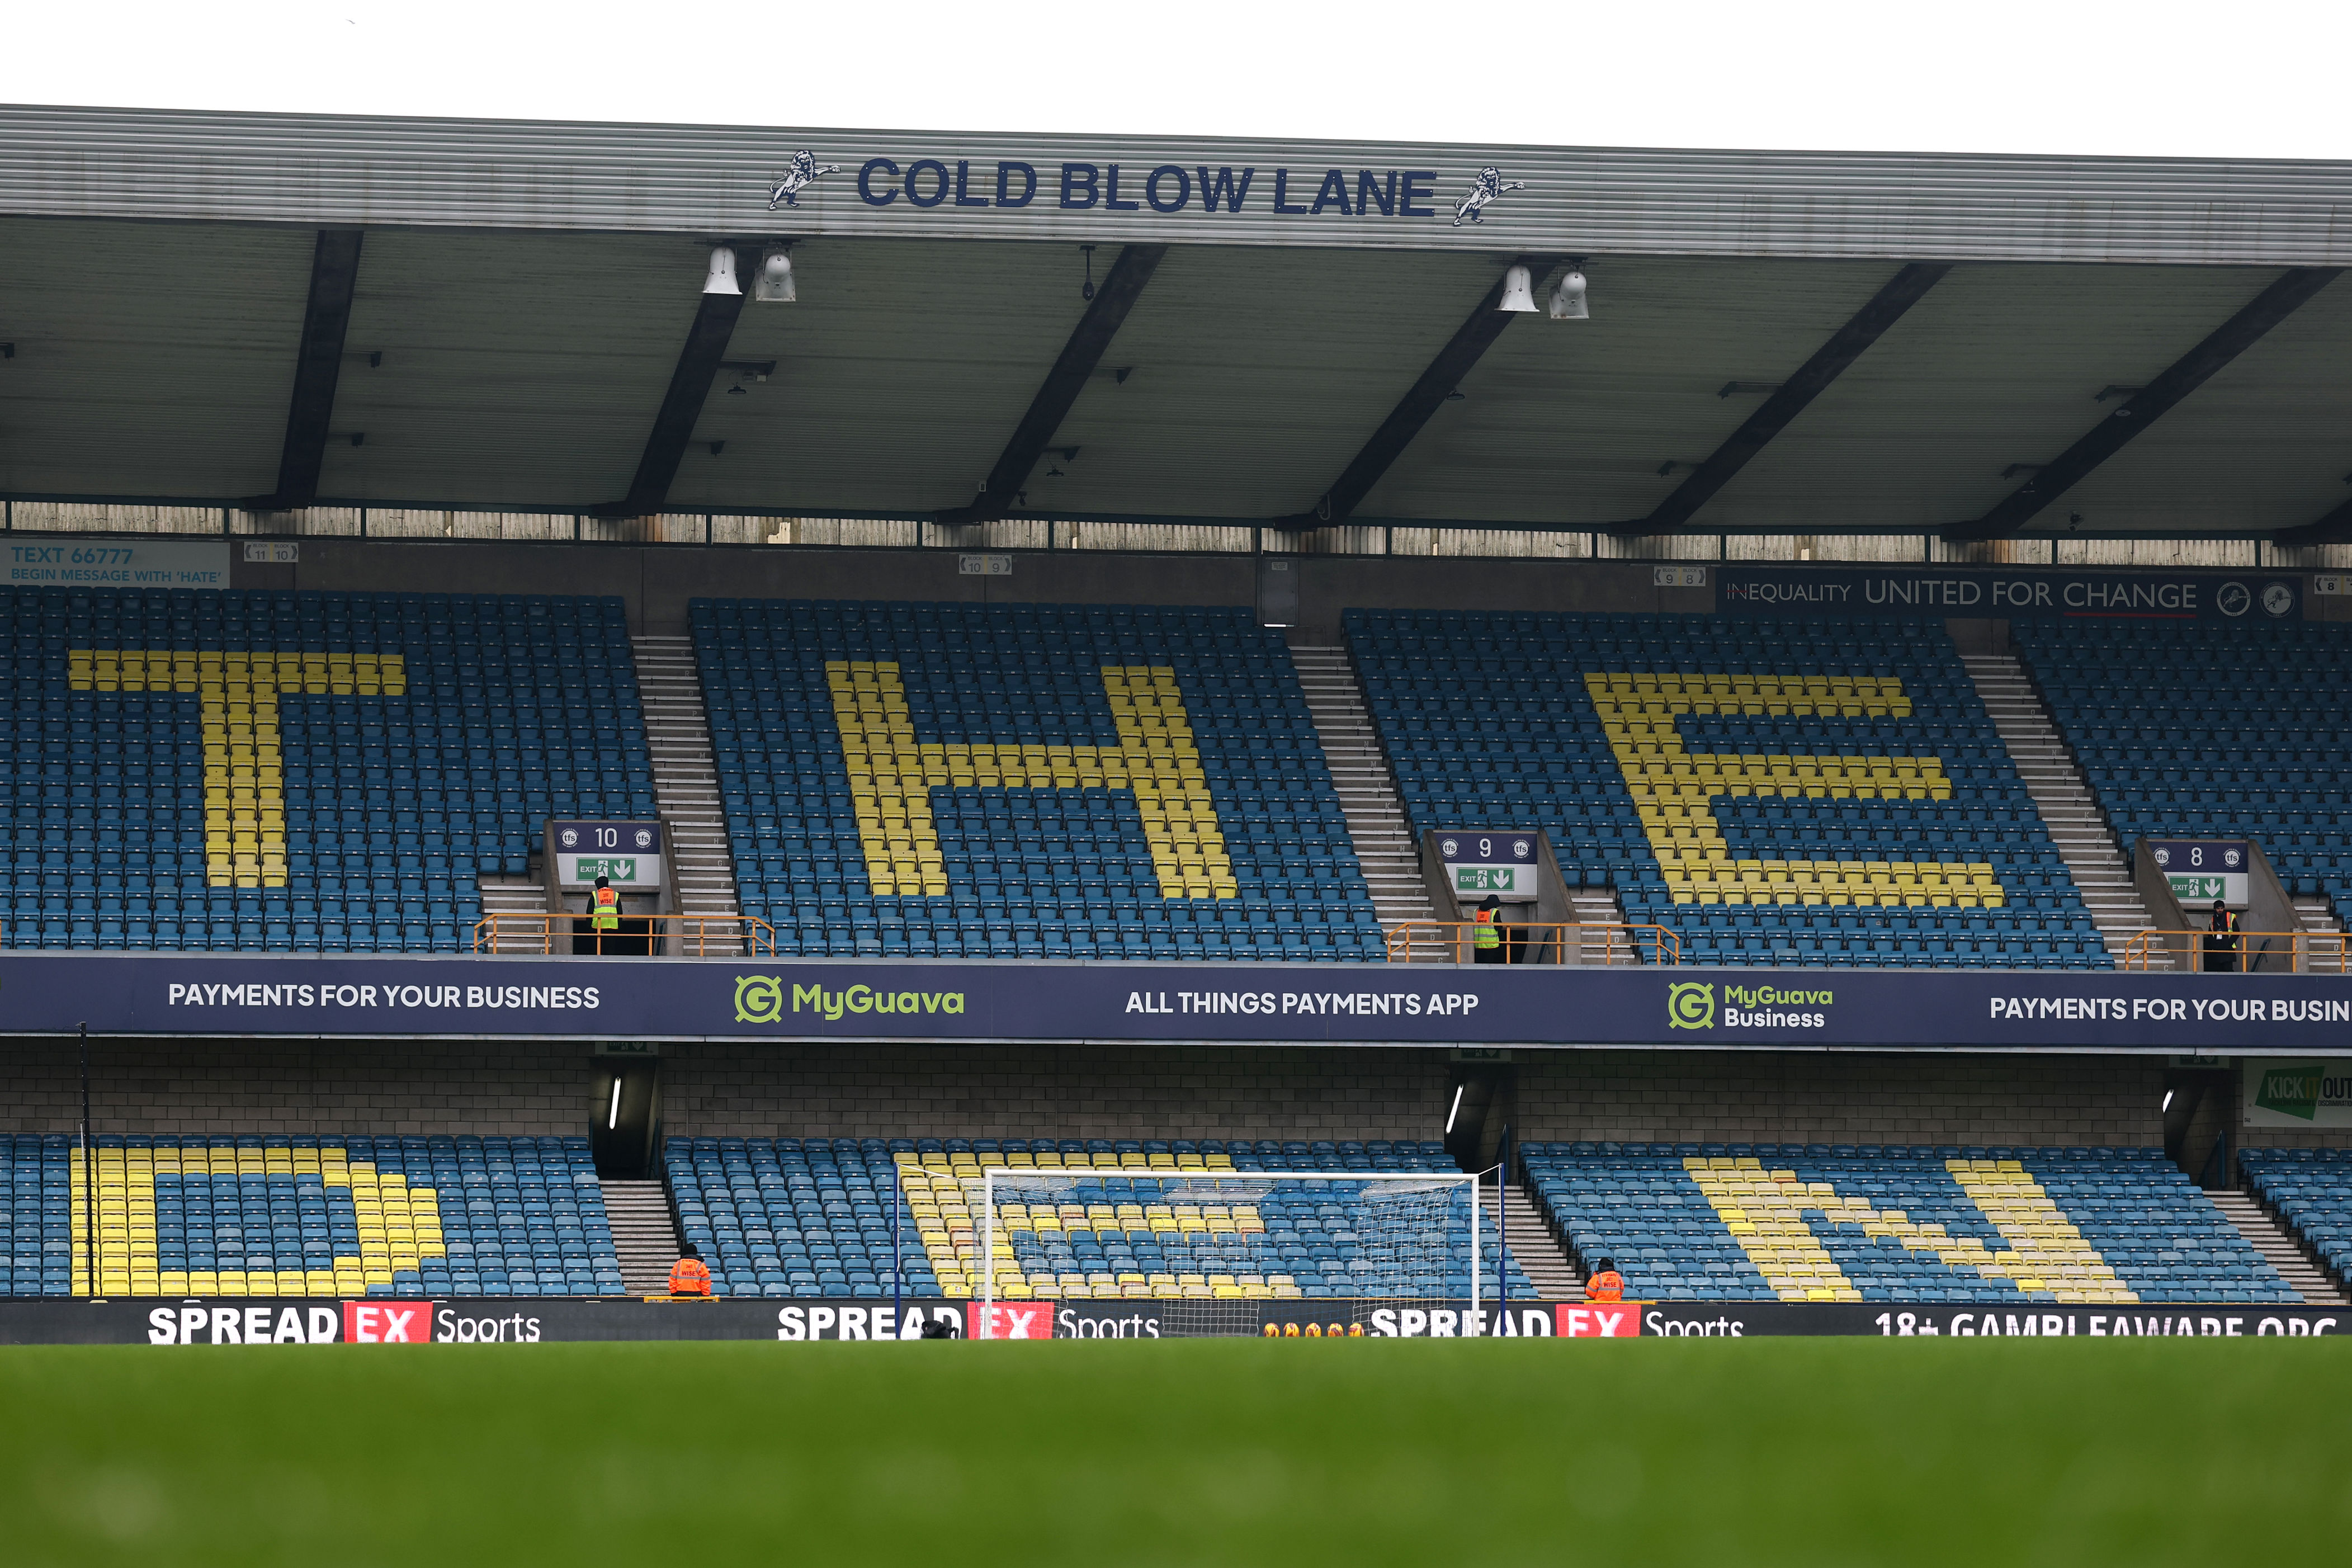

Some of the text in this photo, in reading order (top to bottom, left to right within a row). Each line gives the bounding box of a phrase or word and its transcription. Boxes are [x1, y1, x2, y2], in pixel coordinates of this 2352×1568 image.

[857, 158, 1436, 217] COLD BLOW LANE
[11, 546, 134, 565] TEXT 66777
[255, 550, 266, 560] 11
[276, 551, 288, 560] 10
[11, 568, 56, 581] BEGIN
[60, 569, 130, 582] MESSAGE
[134, 570, 172, 583] WITH
[969, 563, 981, 573] 10
[992, 563, 1000, 573] 9
[1666, 574, 1673, 584] 9
[1686, 575, 1693, 584] 8
[1727, 583, 1852, 604] INEQUALITY
[1865, 579, 1980, 605] UNITED
[1992, 581, 2053, 606] FOR
[2063, 582, 2197, 608] CHANGE
[595, 828, 617, 847] 10
[1479, 838, 1491, 857] 9
[2191, 847, 2203, 866] 8
[169, 983, 600, 1009] PAYMENTS FOR YOUR BUSINESS
[792, 984, 965, 1021] MyGuava
[1125, 991, 1480, 1016] ALL THINGS PAYMENTS APP
[1725, 985, 1833, 1009] MyGuava
[1725, 1008, 1825, 1028] Business
[1991, 997, 2352, 1022] PAYMENTS FOR YOUR BUSIN
[2268, 1076, 2352, 1099] KICK IT OUT
[437, 1309, 540, 1343] Sports
[1060, 1309, 1160, 1339] Sports
[1875, 1312, 1939, 1336] 18+
